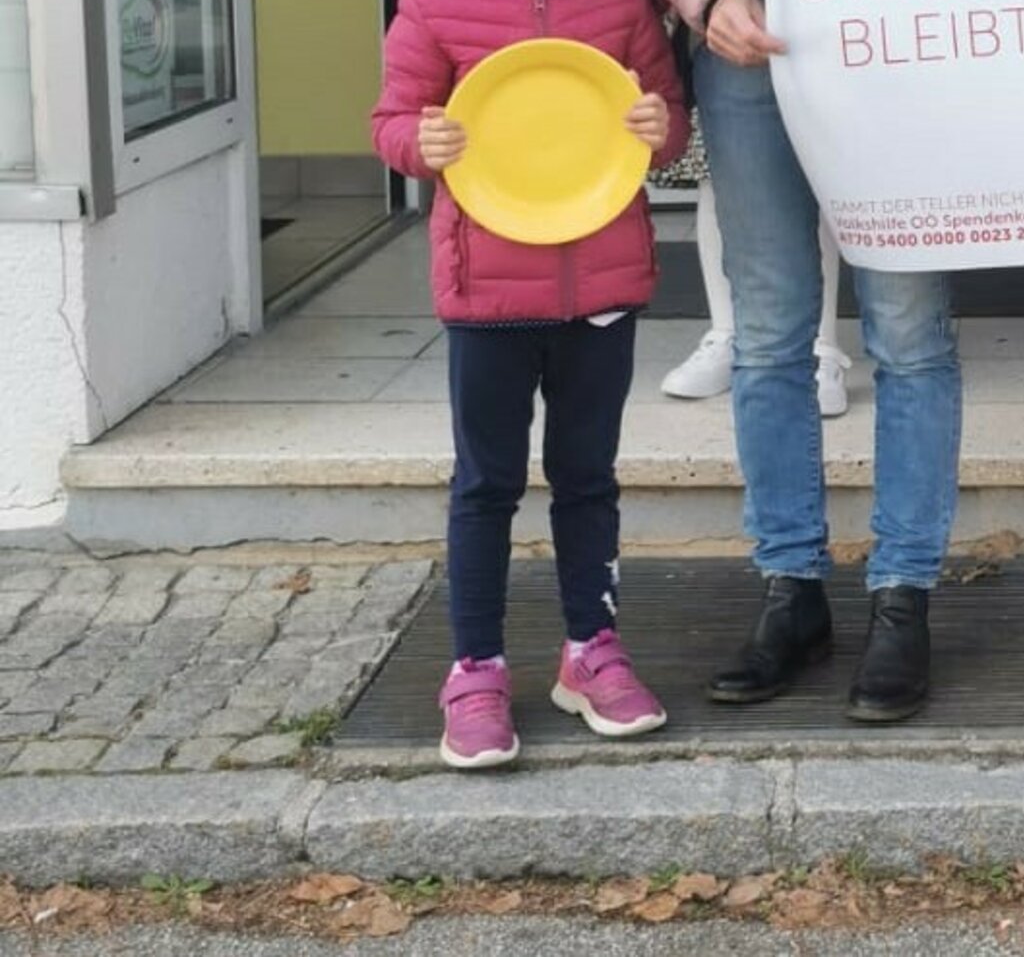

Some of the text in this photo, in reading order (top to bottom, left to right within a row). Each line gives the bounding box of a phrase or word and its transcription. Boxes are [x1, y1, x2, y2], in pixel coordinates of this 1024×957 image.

[829, 199, 878, 215] DAMIT
[880, 197, 915, 214] DER
[916, 194, 977, 211] TELLER
[875, 232, 918, 248] 5400
[921, 230, 966, 247] 0000
[969, 227, 1013, 244] 0023
